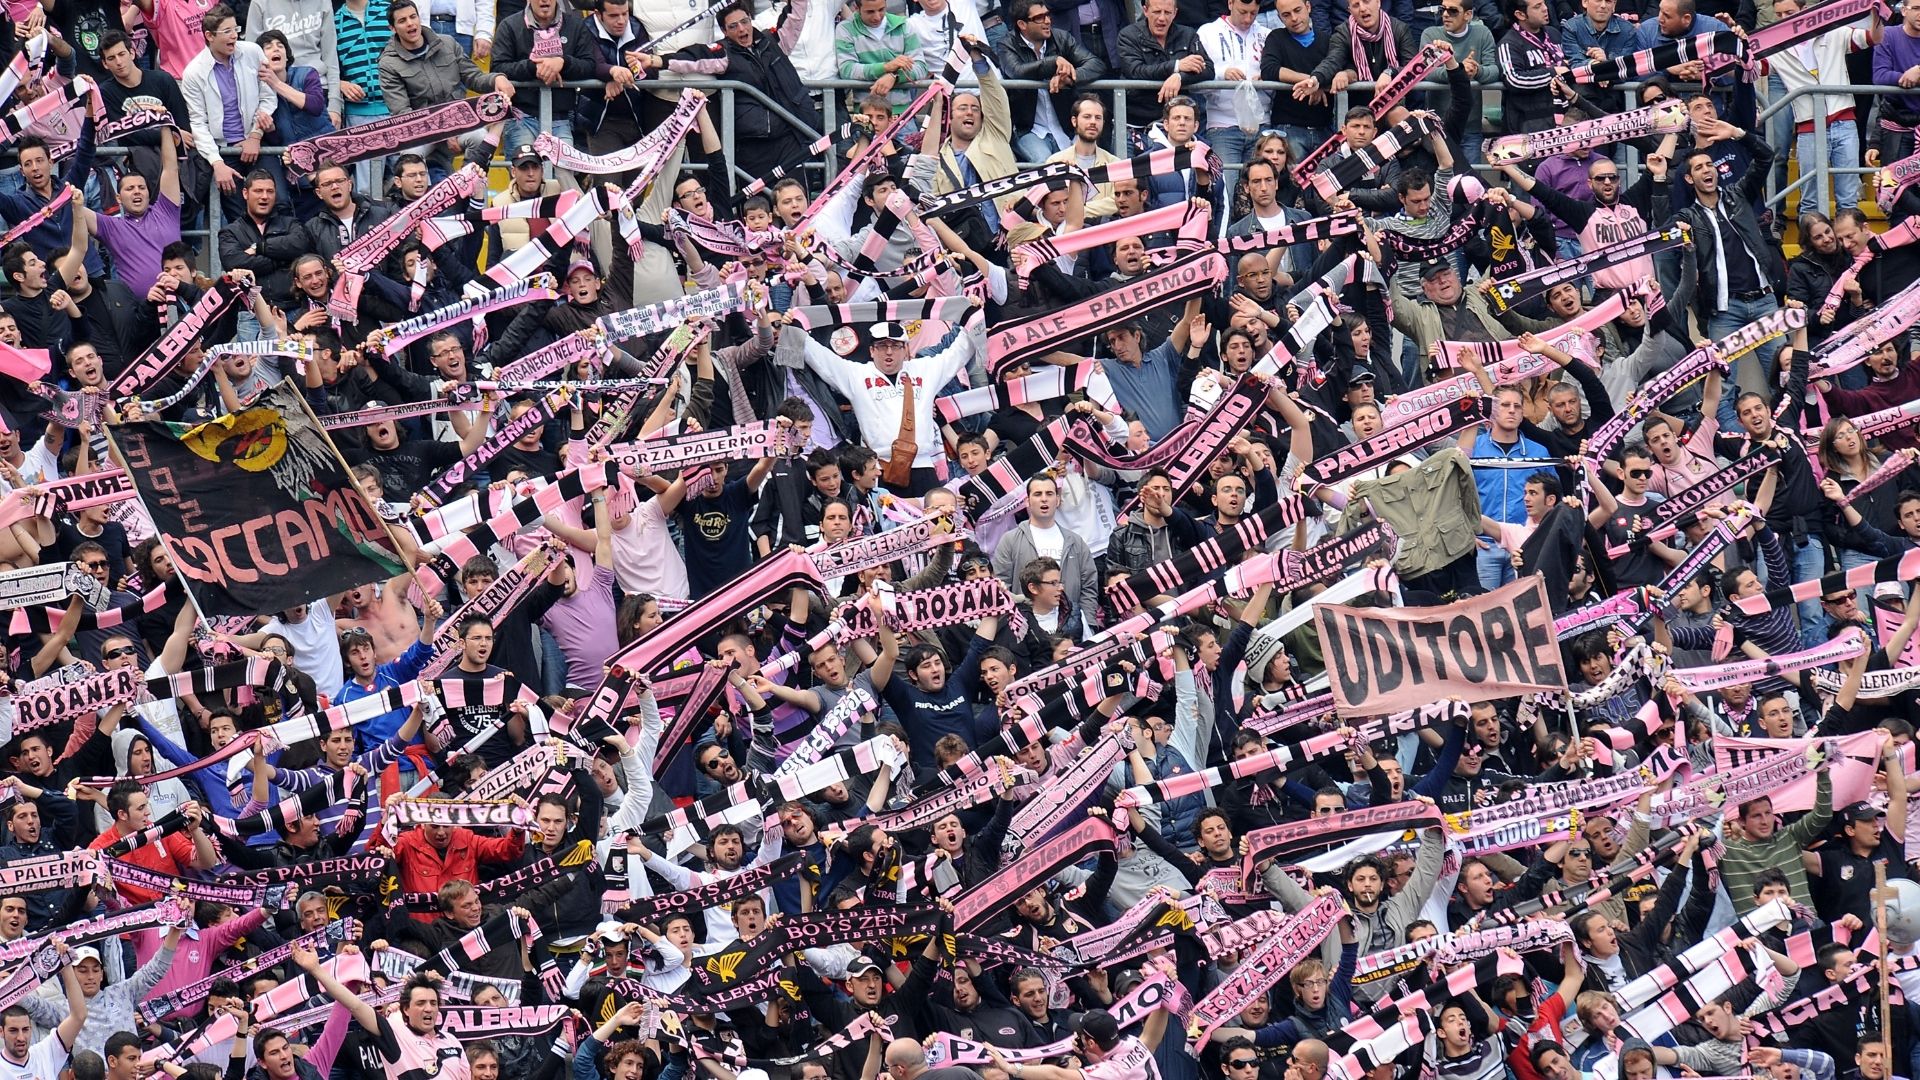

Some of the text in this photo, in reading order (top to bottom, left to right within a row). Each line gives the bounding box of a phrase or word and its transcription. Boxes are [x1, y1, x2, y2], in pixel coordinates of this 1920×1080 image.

[1493, 258, 1519, 275] BOYS
[685, 290, 722, 306] SONO SANO
[1088, 267, 1199, 319] PALERMO
[398, 294, 473, 338] PALERMO
[614, 308, 654, 325] SONO BELLO
[115, 287, 225, 397] PALERMO
[553, 343, 575, 363] NEL
[873, 387, 923, 402] GIBSN
[466, 407, 544, 475] PALERMO
[681, 432, 769, 459] PALERMO
[1315, 406, 1453, 479] PALERMO
[1655, 450, 1769, 522] WARRIORS
[839, 523, 933, 562] PALERMO
[1325, 528, 1382, 566] CATANESE
[1320, 584, 1565, 702] UDITORE
[1007, 671, 1065, 701] FORZA
[463, 703, 500, 717] HI-RISE
[477, 750, 548, 800] PALERMO
[1058, 797, 1081, 821] GRIDO
[1082, 756, 1120, 796] ANDIAMOCI
[1724, 755, 1809, 798] PALERMO
[911, 774, 990, 819] PALERMO
[1247, 800, 1429, 847] Forza Palermo
[1494, 818, 1542, 843] ODIO
[15, 857, 99, 884] PALERMO
[282, 856, 386, 884] PALERMO
[1015, 824, 1096, 883] Palermo
[111, 863, 172, 889] ULTRAS
[474, 856, 556, 896] ULTRAS
[653, 862, 774, 911] BOYS ZEN
[700, 885, 766, 909] LIBERI
[785, 911, 908, 940] BOYS ZEN
[757, 925, 898, 966] ULTRAS LIBERI
[1202, 897, 1337, 1020] FORZA PALERMO
[614, 979, 687, 1007] ULTRAS
[694, 965, 712, 987] ZEN
